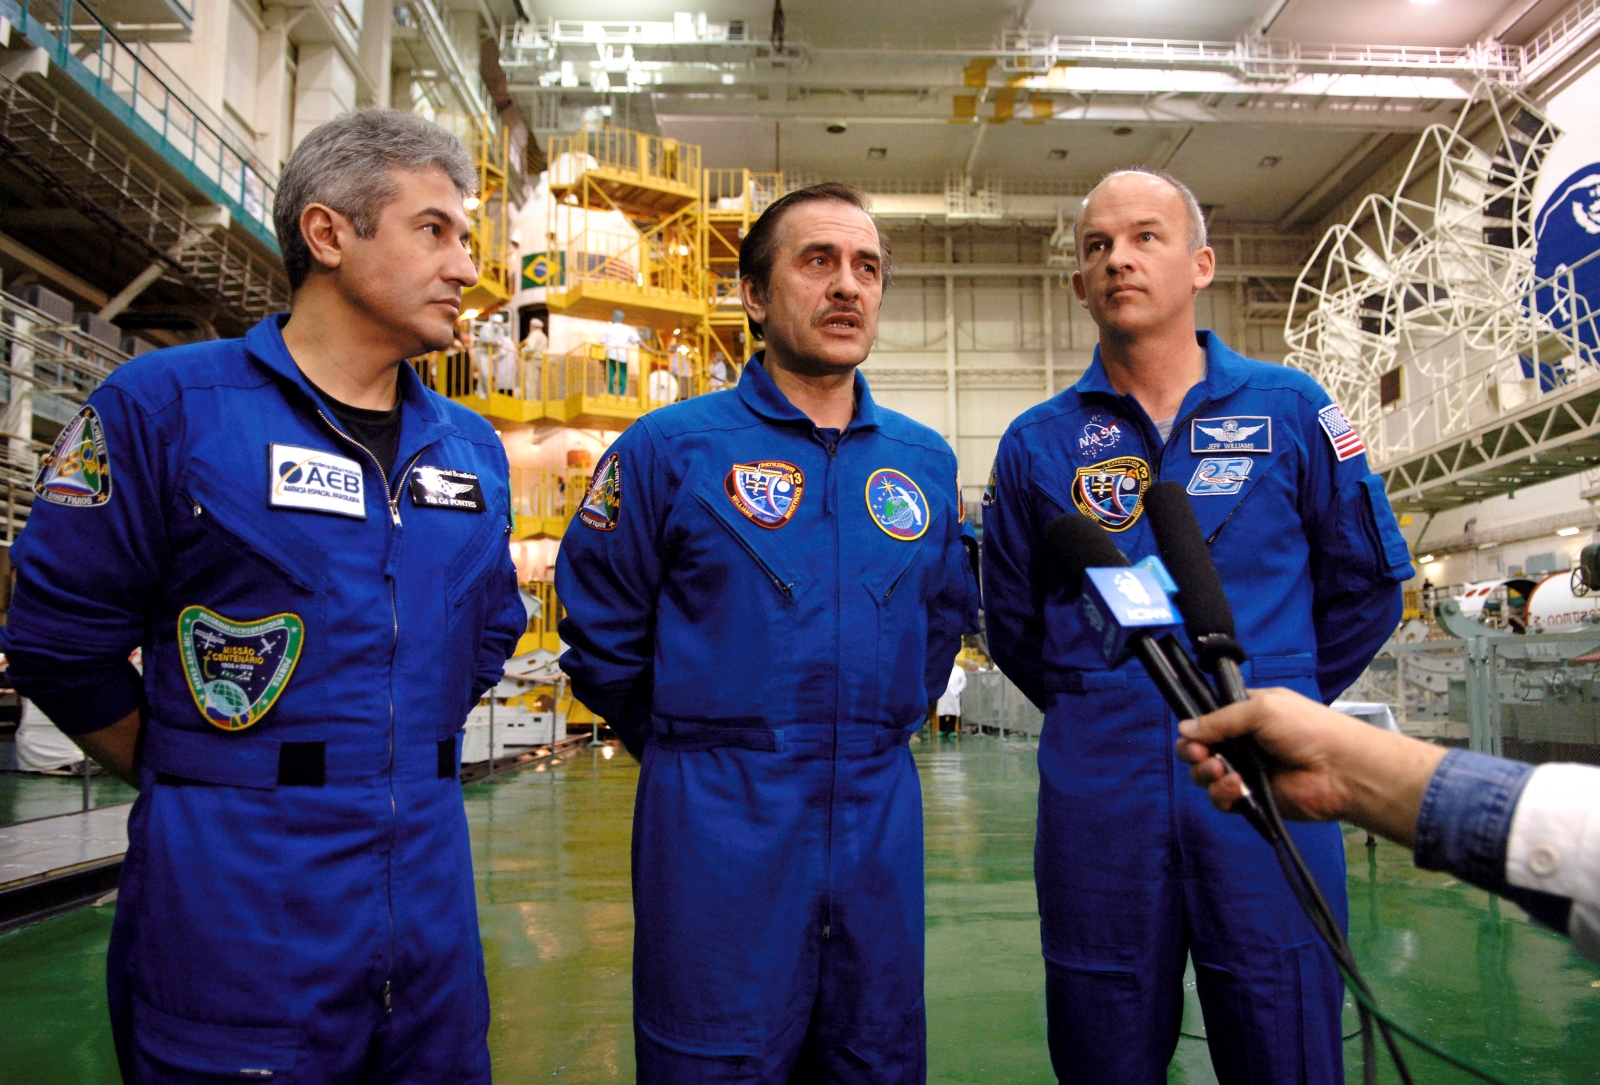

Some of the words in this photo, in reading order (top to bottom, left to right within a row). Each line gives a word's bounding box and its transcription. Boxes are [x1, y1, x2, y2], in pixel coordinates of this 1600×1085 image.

[1078, 425, 1121, 449] NASA
[1223, 442, 1254, 450] WILLIAMS
[1107, 459, 1141, 469] EXPEDITION
[305, 466, 360, 494] AEB
[788, 472, 803, 485] 13
[1134, 466, 1149, 480] 13
[1194, 461, 1244, 491] 25
[449, 498, 477, 508] PONTES
[731, 494, 754, 518] WILLIAMS
[199, 612, 230, 632] PROGRAMA
[230, 617, 286, 634] MICROGRAVIDADE
[222, 646, 256, 656] MISSÃO
[212, 652, 265, 665] CENTENÁRIO
[272, 657, 293, 688] PONTES
